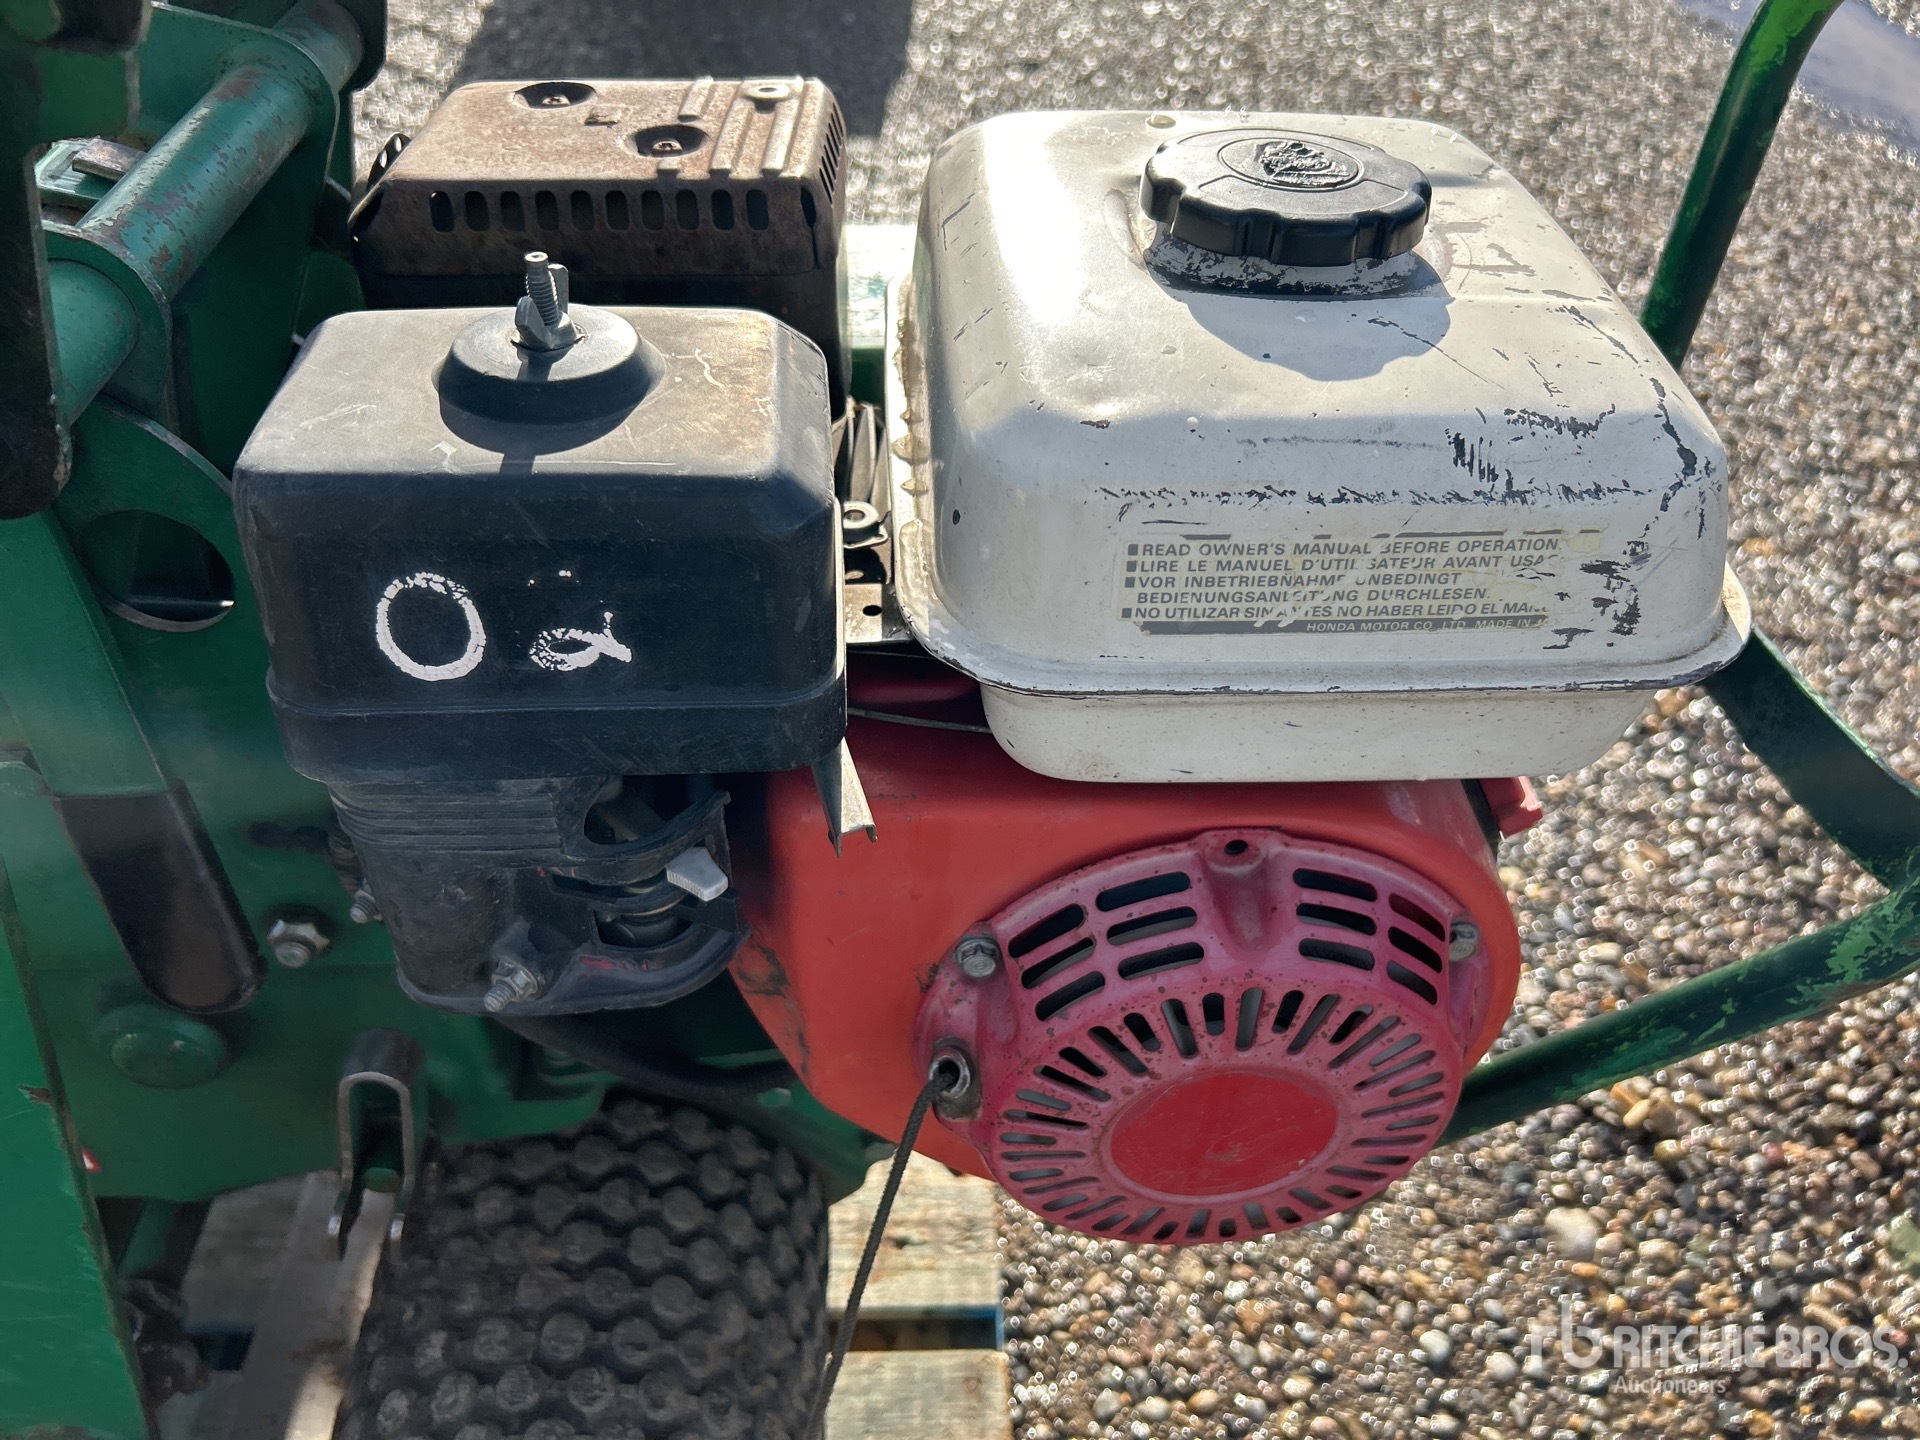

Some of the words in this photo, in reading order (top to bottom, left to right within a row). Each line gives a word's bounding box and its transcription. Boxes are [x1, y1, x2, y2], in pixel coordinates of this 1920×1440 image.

[1142, 543, 1191, 556] READ
[1199, 543, 1286, 556] OWNER'S
[1293, 542, 1372, 555] MANUAL
[1457, 538, 1562, 552] OPERATION.
[1140, 560, 1179, 572] LIRE
[1187, 560, 1207, 572] LE
[1215, 559, 1293, 572] MANUEL
[1301, 557, 1435, 571] D'UTILSATEUR
[1443, 556, 1503, 569] AVANT
[1138, 576, 1176, 588] VOR
[1367, 588, 1491, 602] DURCHLESEN.
[1135, 607, 1161, 619] NO
[1165, 607, 1240, 619] UTILIZAR
[1244, 606, 1274, 618] SIN
[1336, 605, 1362, 618] NO
[1365, 604, 1424, 617] HABER
[1480, 603, 1499, 615] EL
[1306, 622, 1356, 632] HONDA
[1360, 621, 1409, 631] MOTOR
[1474, 619, 1513, 629] MADE
[1517, 618, 1531, 627] IN
